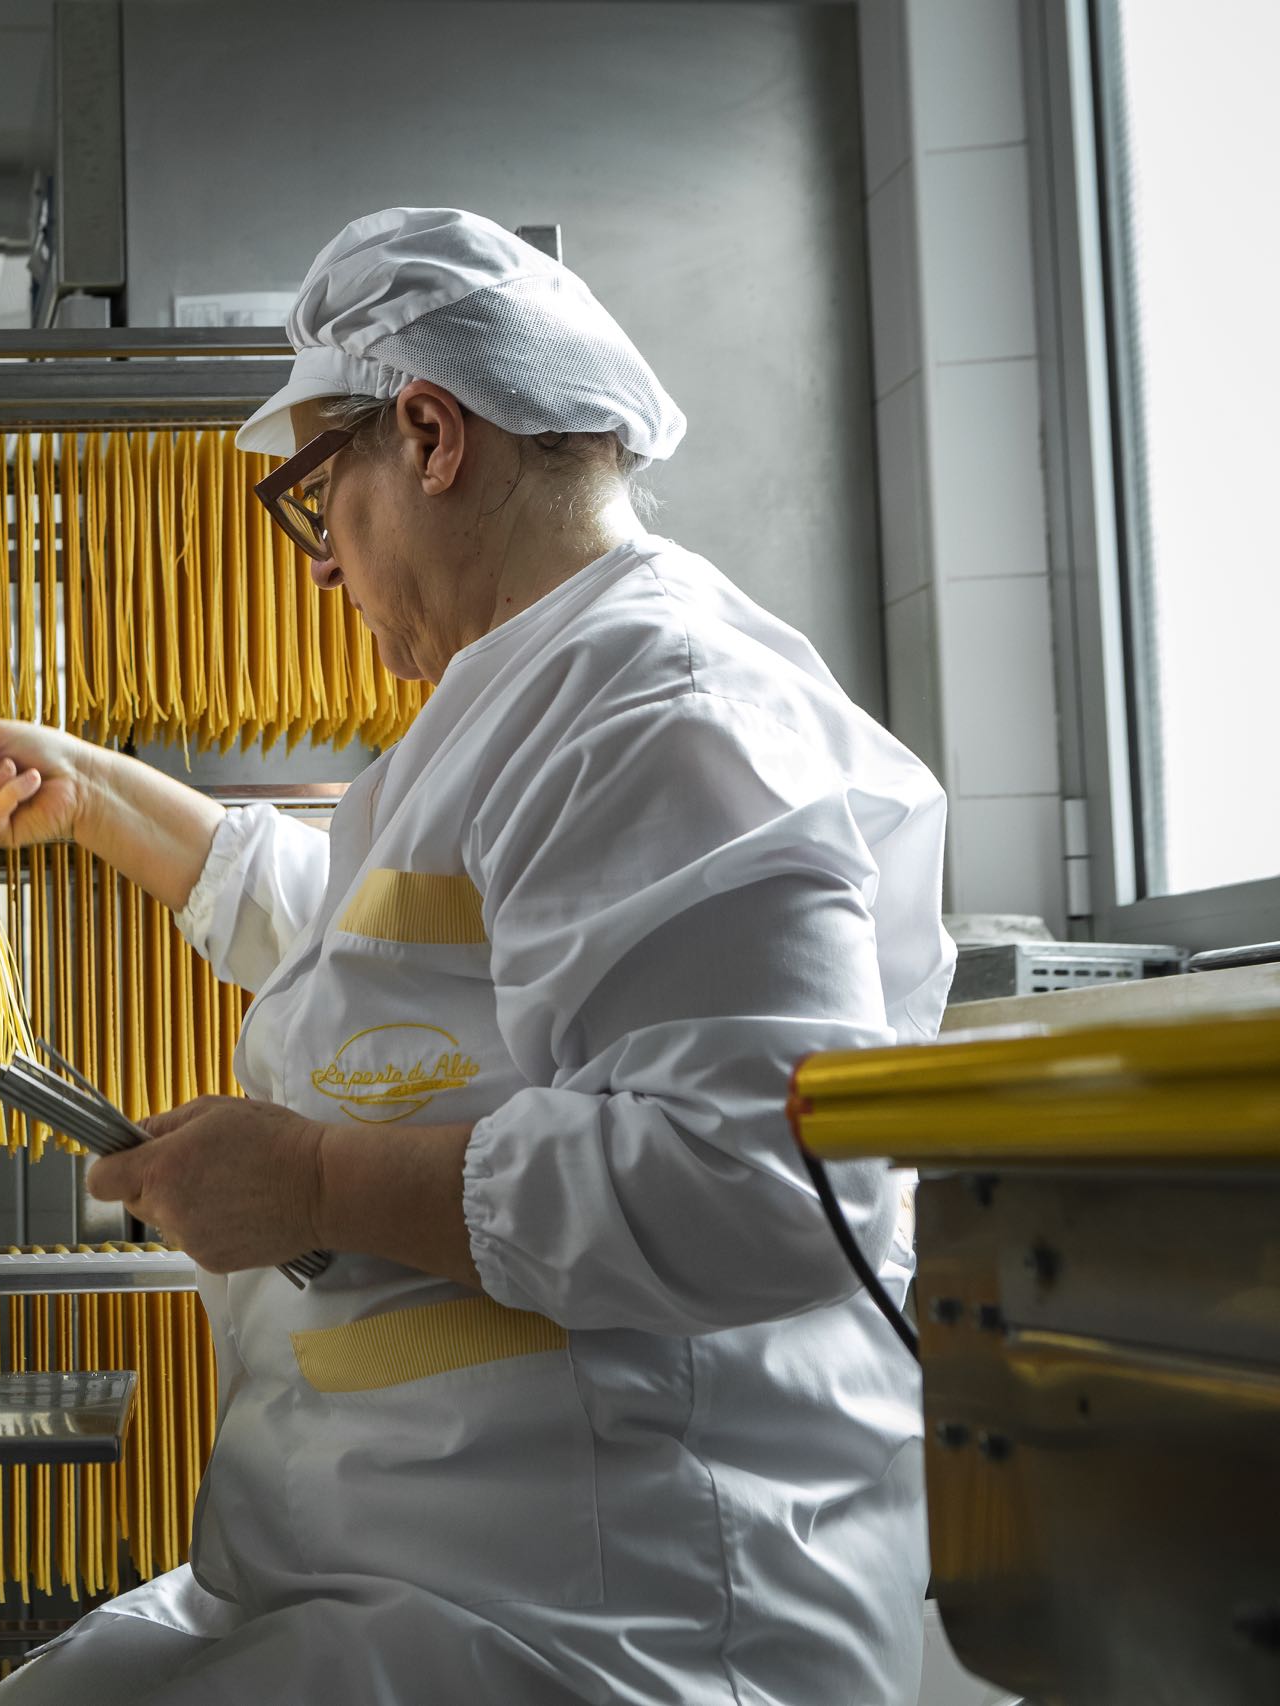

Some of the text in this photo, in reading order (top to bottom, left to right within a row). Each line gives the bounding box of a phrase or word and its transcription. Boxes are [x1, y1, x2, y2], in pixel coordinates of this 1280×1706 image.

[317, 1053, 480, 1091] La pasta di Aldo
